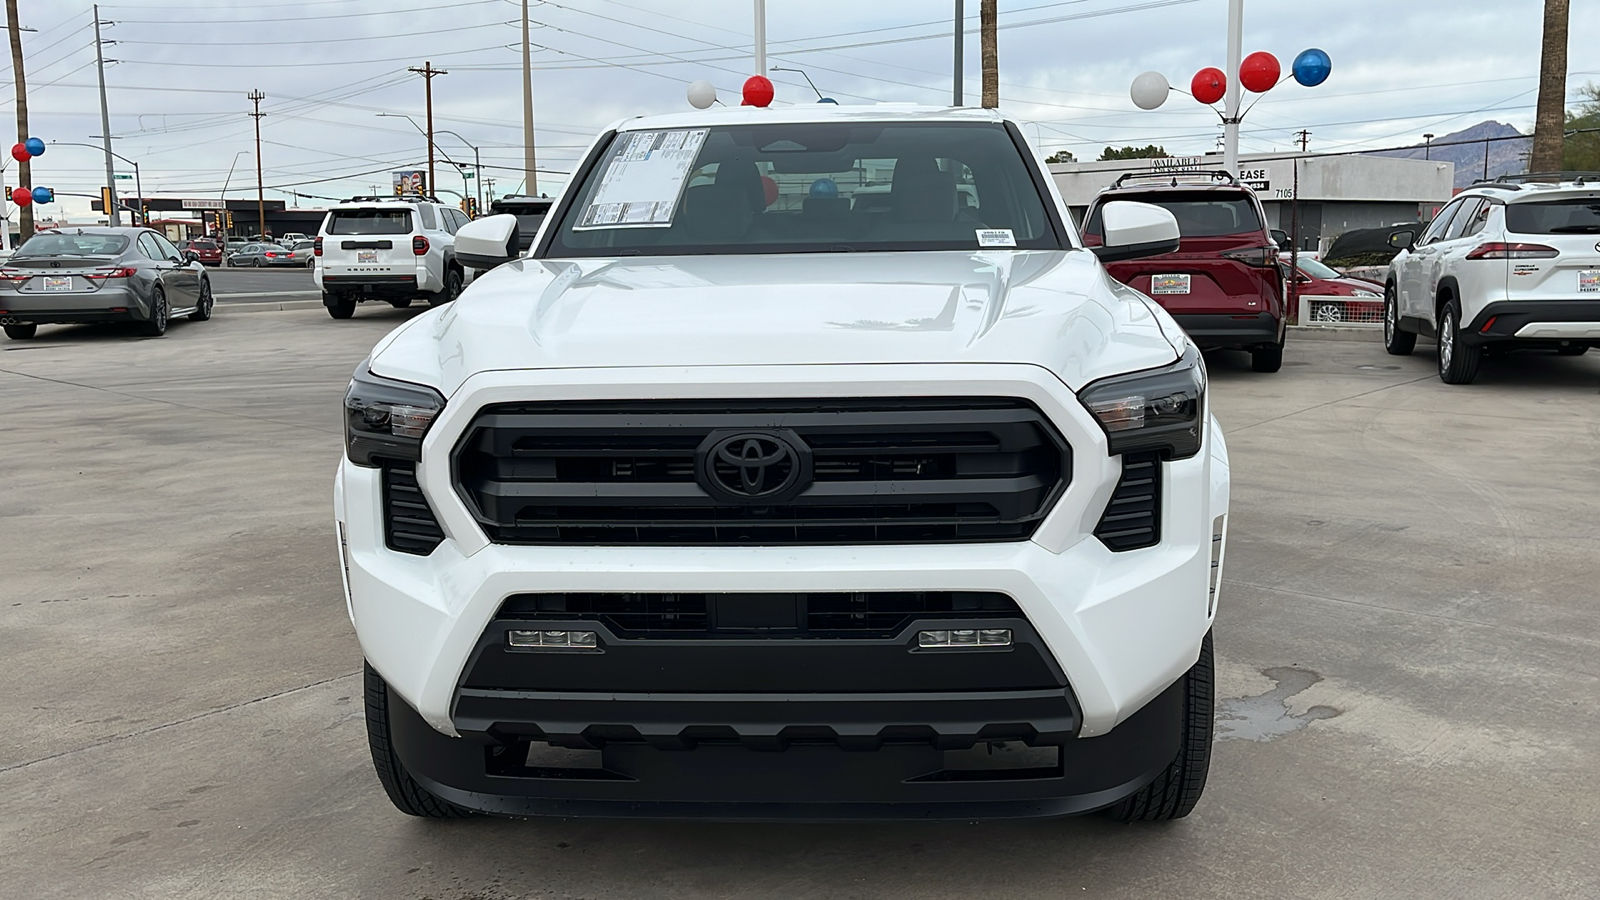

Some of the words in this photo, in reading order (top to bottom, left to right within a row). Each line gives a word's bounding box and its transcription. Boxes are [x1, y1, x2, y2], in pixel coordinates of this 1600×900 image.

[1152, 158, 1199, 167] AVAILABLE
[1237, 170, 1265, 179] EASE
[1276, 189, 1292, 198] 7105
